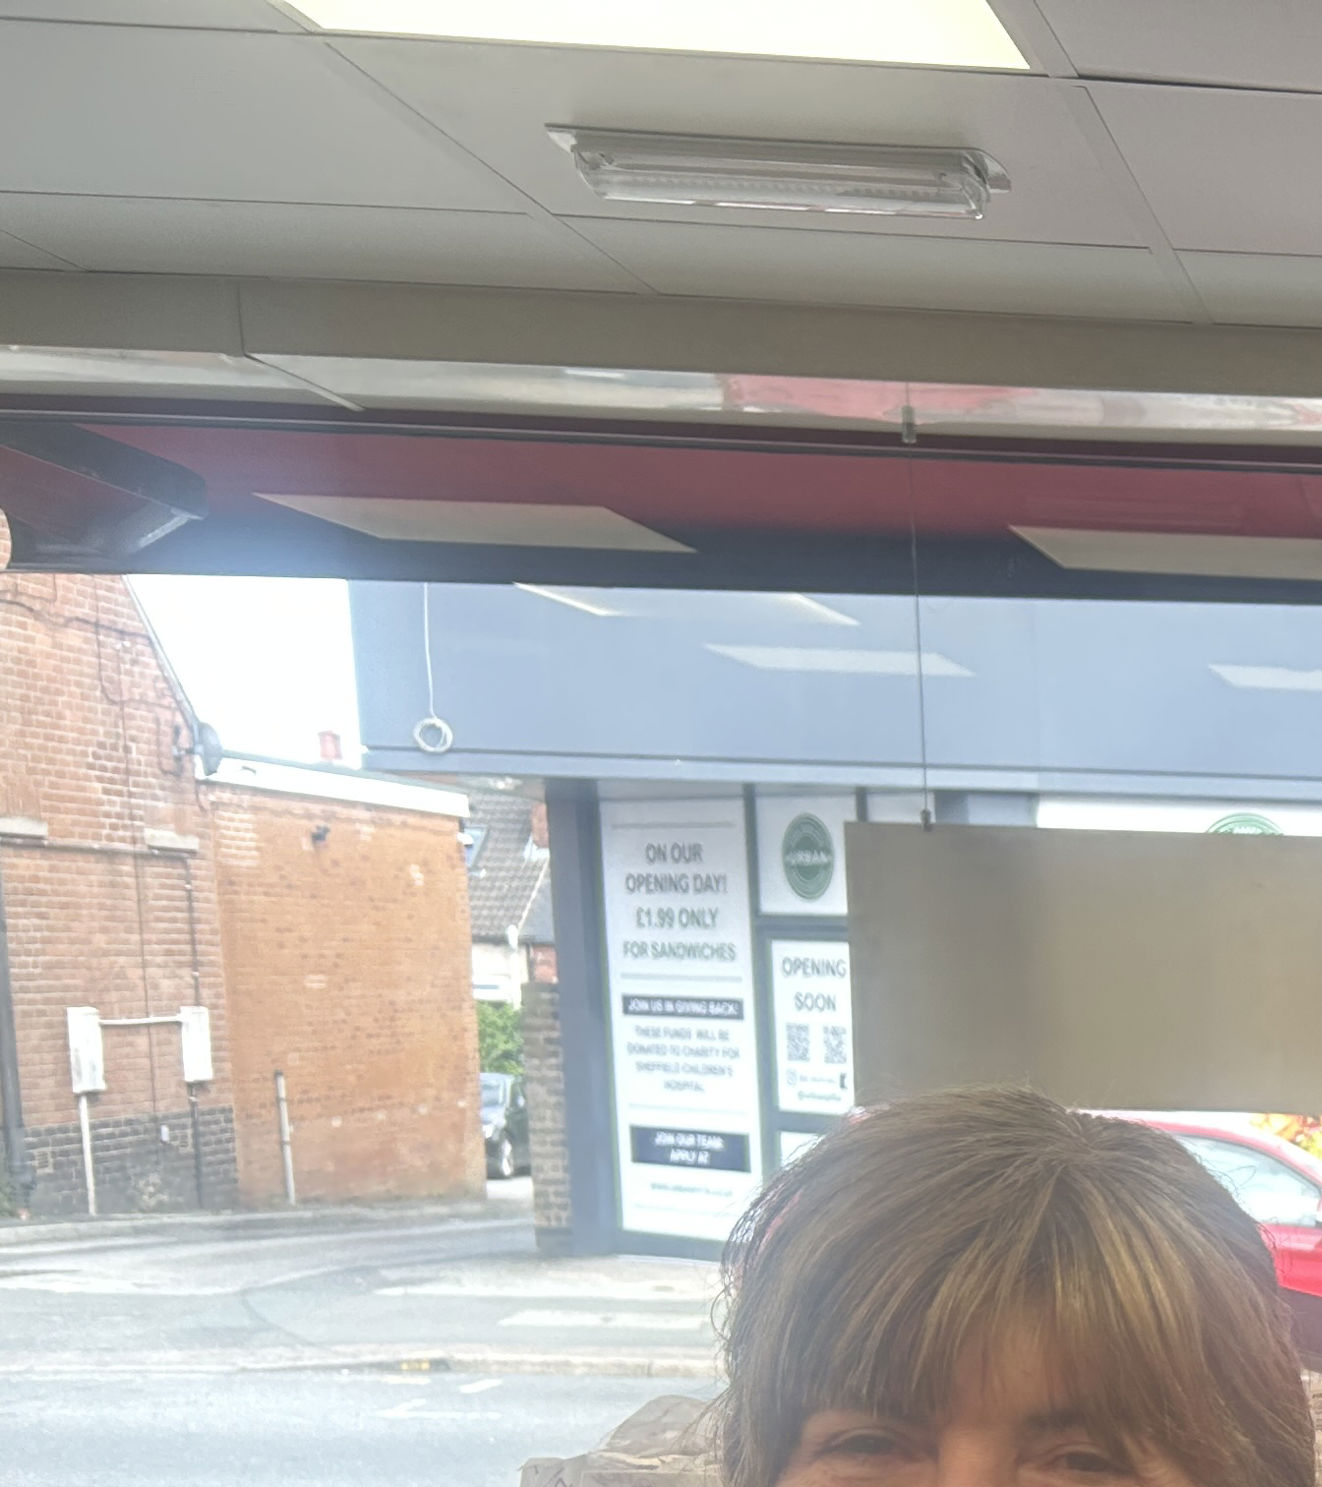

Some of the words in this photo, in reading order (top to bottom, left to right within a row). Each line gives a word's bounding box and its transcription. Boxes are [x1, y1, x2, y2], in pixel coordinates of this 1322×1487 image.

[645, 843, 667, 864] ON
[670, 842, 704, 863] OUR
[625, 873, 690, 894] OPENING
[693, 873, 728, 894] DAY!
[636, 907, 675, 928] £1.99
[679, 907, 719, 929] ONLY
[623, 940, 649, 958] FOR
[651, 941, 737, 962] SANDWICHES
[782, 957, 847, 978] OPENING
[650, 999, 663, 1012] US
[794, 991, 837, 1012] SOON
